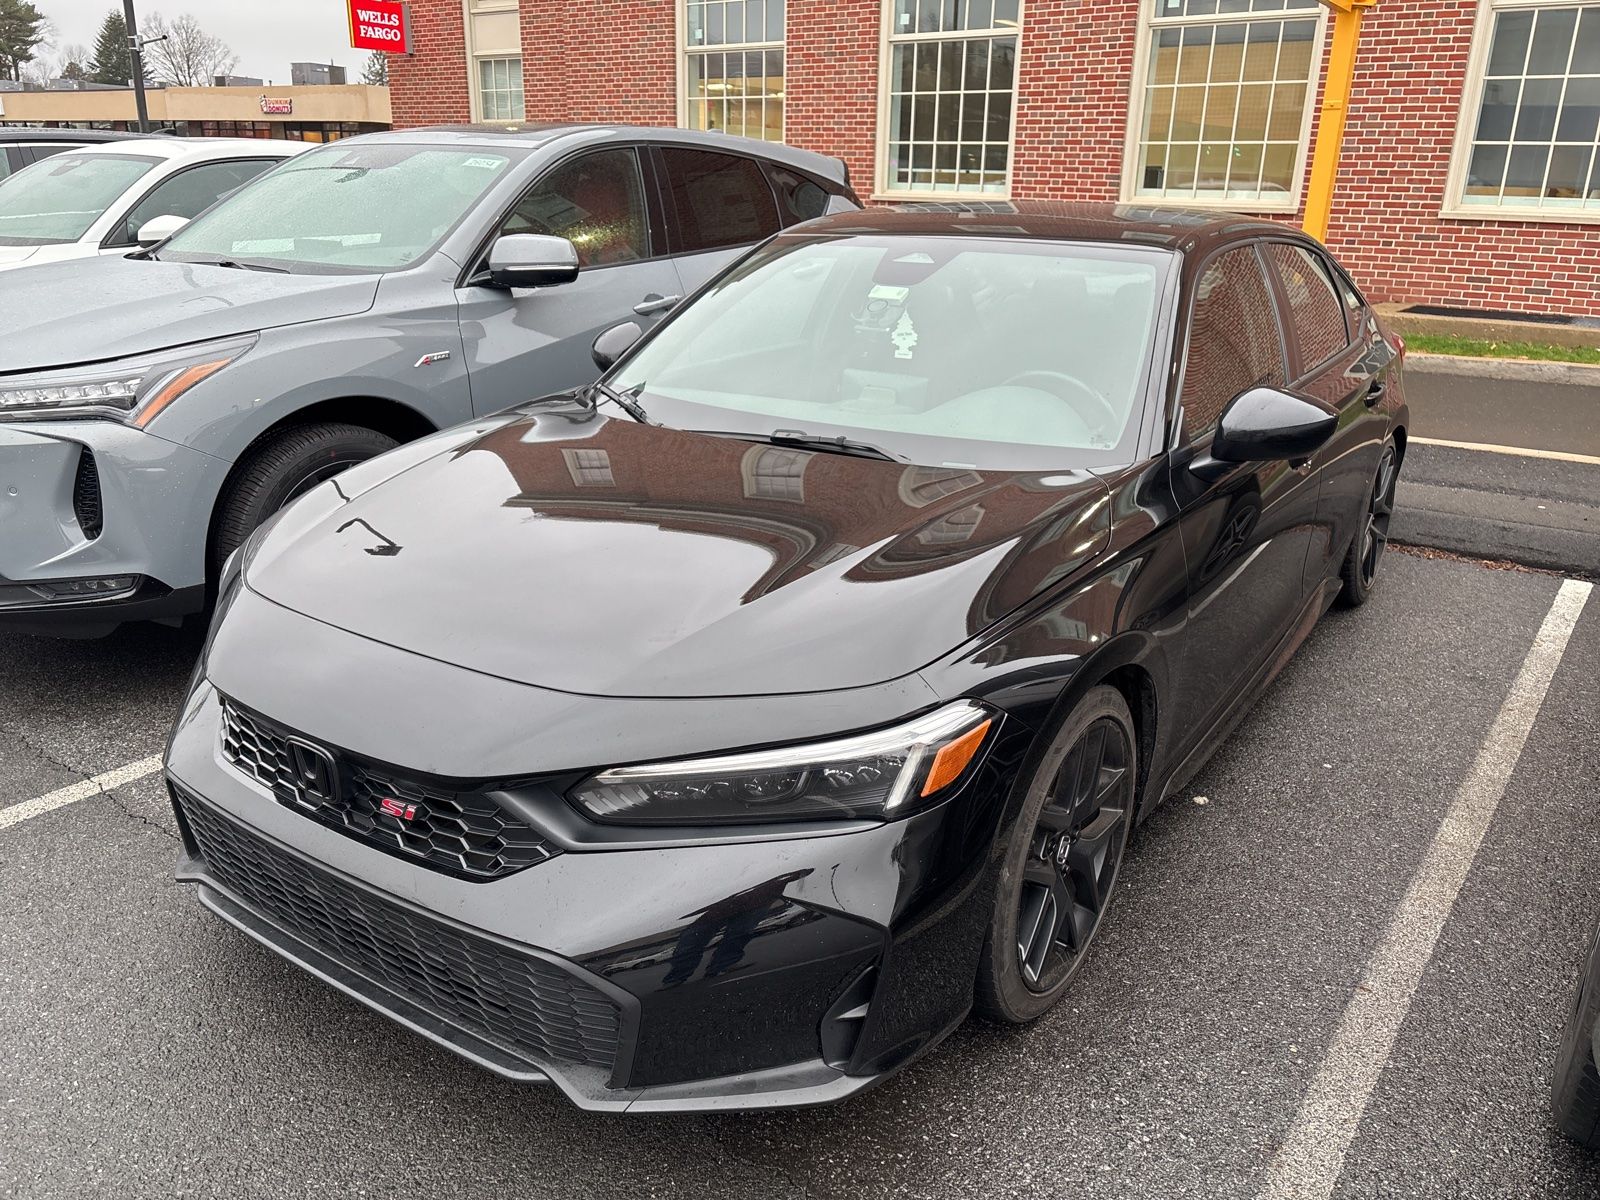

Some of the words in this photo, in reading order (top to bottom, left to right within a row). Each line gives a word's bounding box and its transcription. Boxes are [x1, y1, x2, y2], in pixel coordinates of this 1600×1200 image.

[356, 9, 400, 27] WELLS
[359, 25, 401, 42] FARGO
[379, 798, 417, 821] Si
